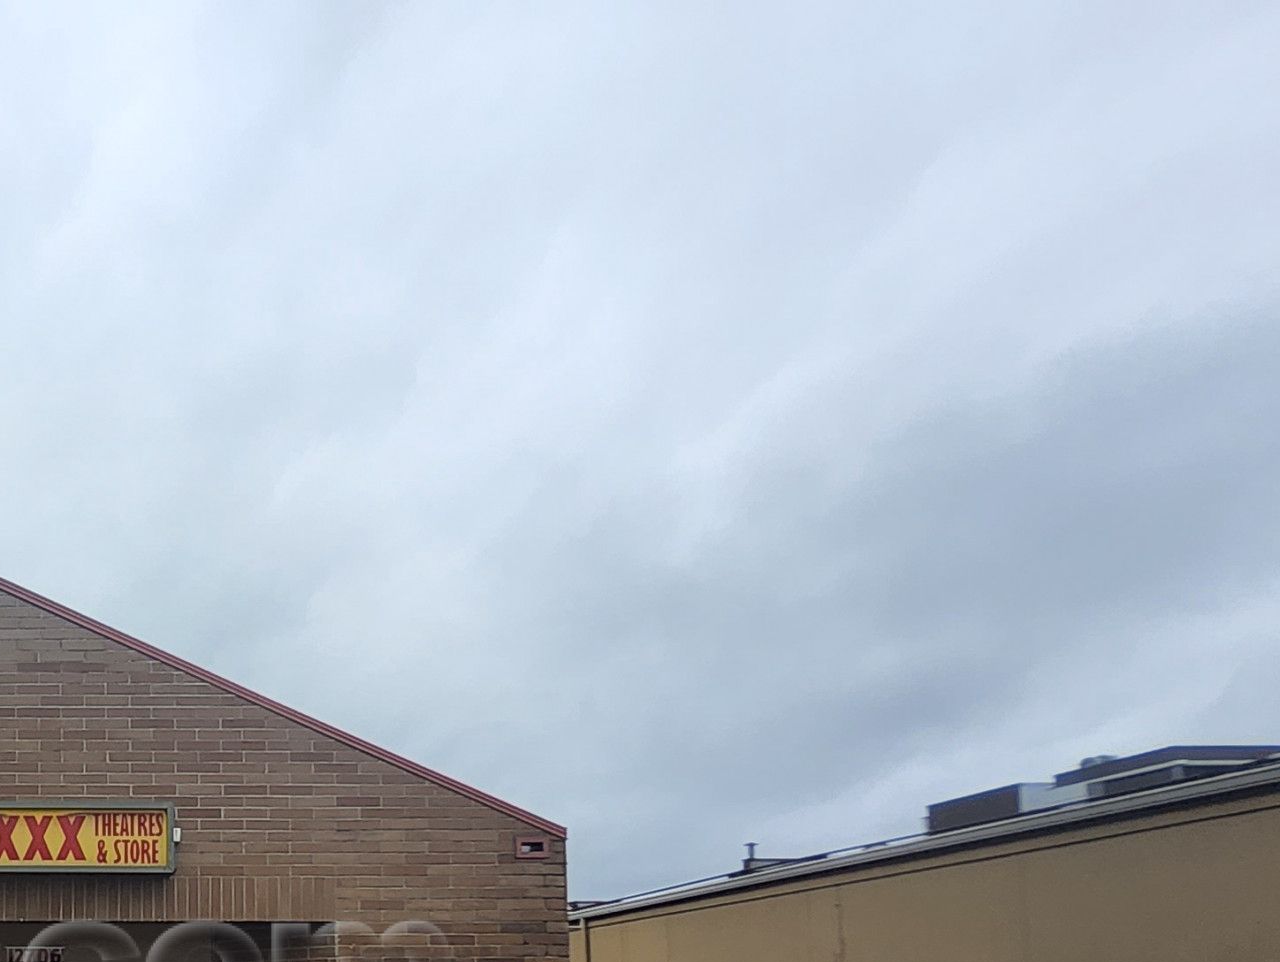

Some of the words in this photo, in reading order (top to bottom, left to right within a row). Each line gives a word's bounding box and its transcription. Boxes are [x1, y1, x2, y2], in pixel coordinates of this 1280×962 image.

[93, 813, 164, 837] THEATRES
[96, 840, 108, 864] &
[114, 840, 159, 864] STORE
